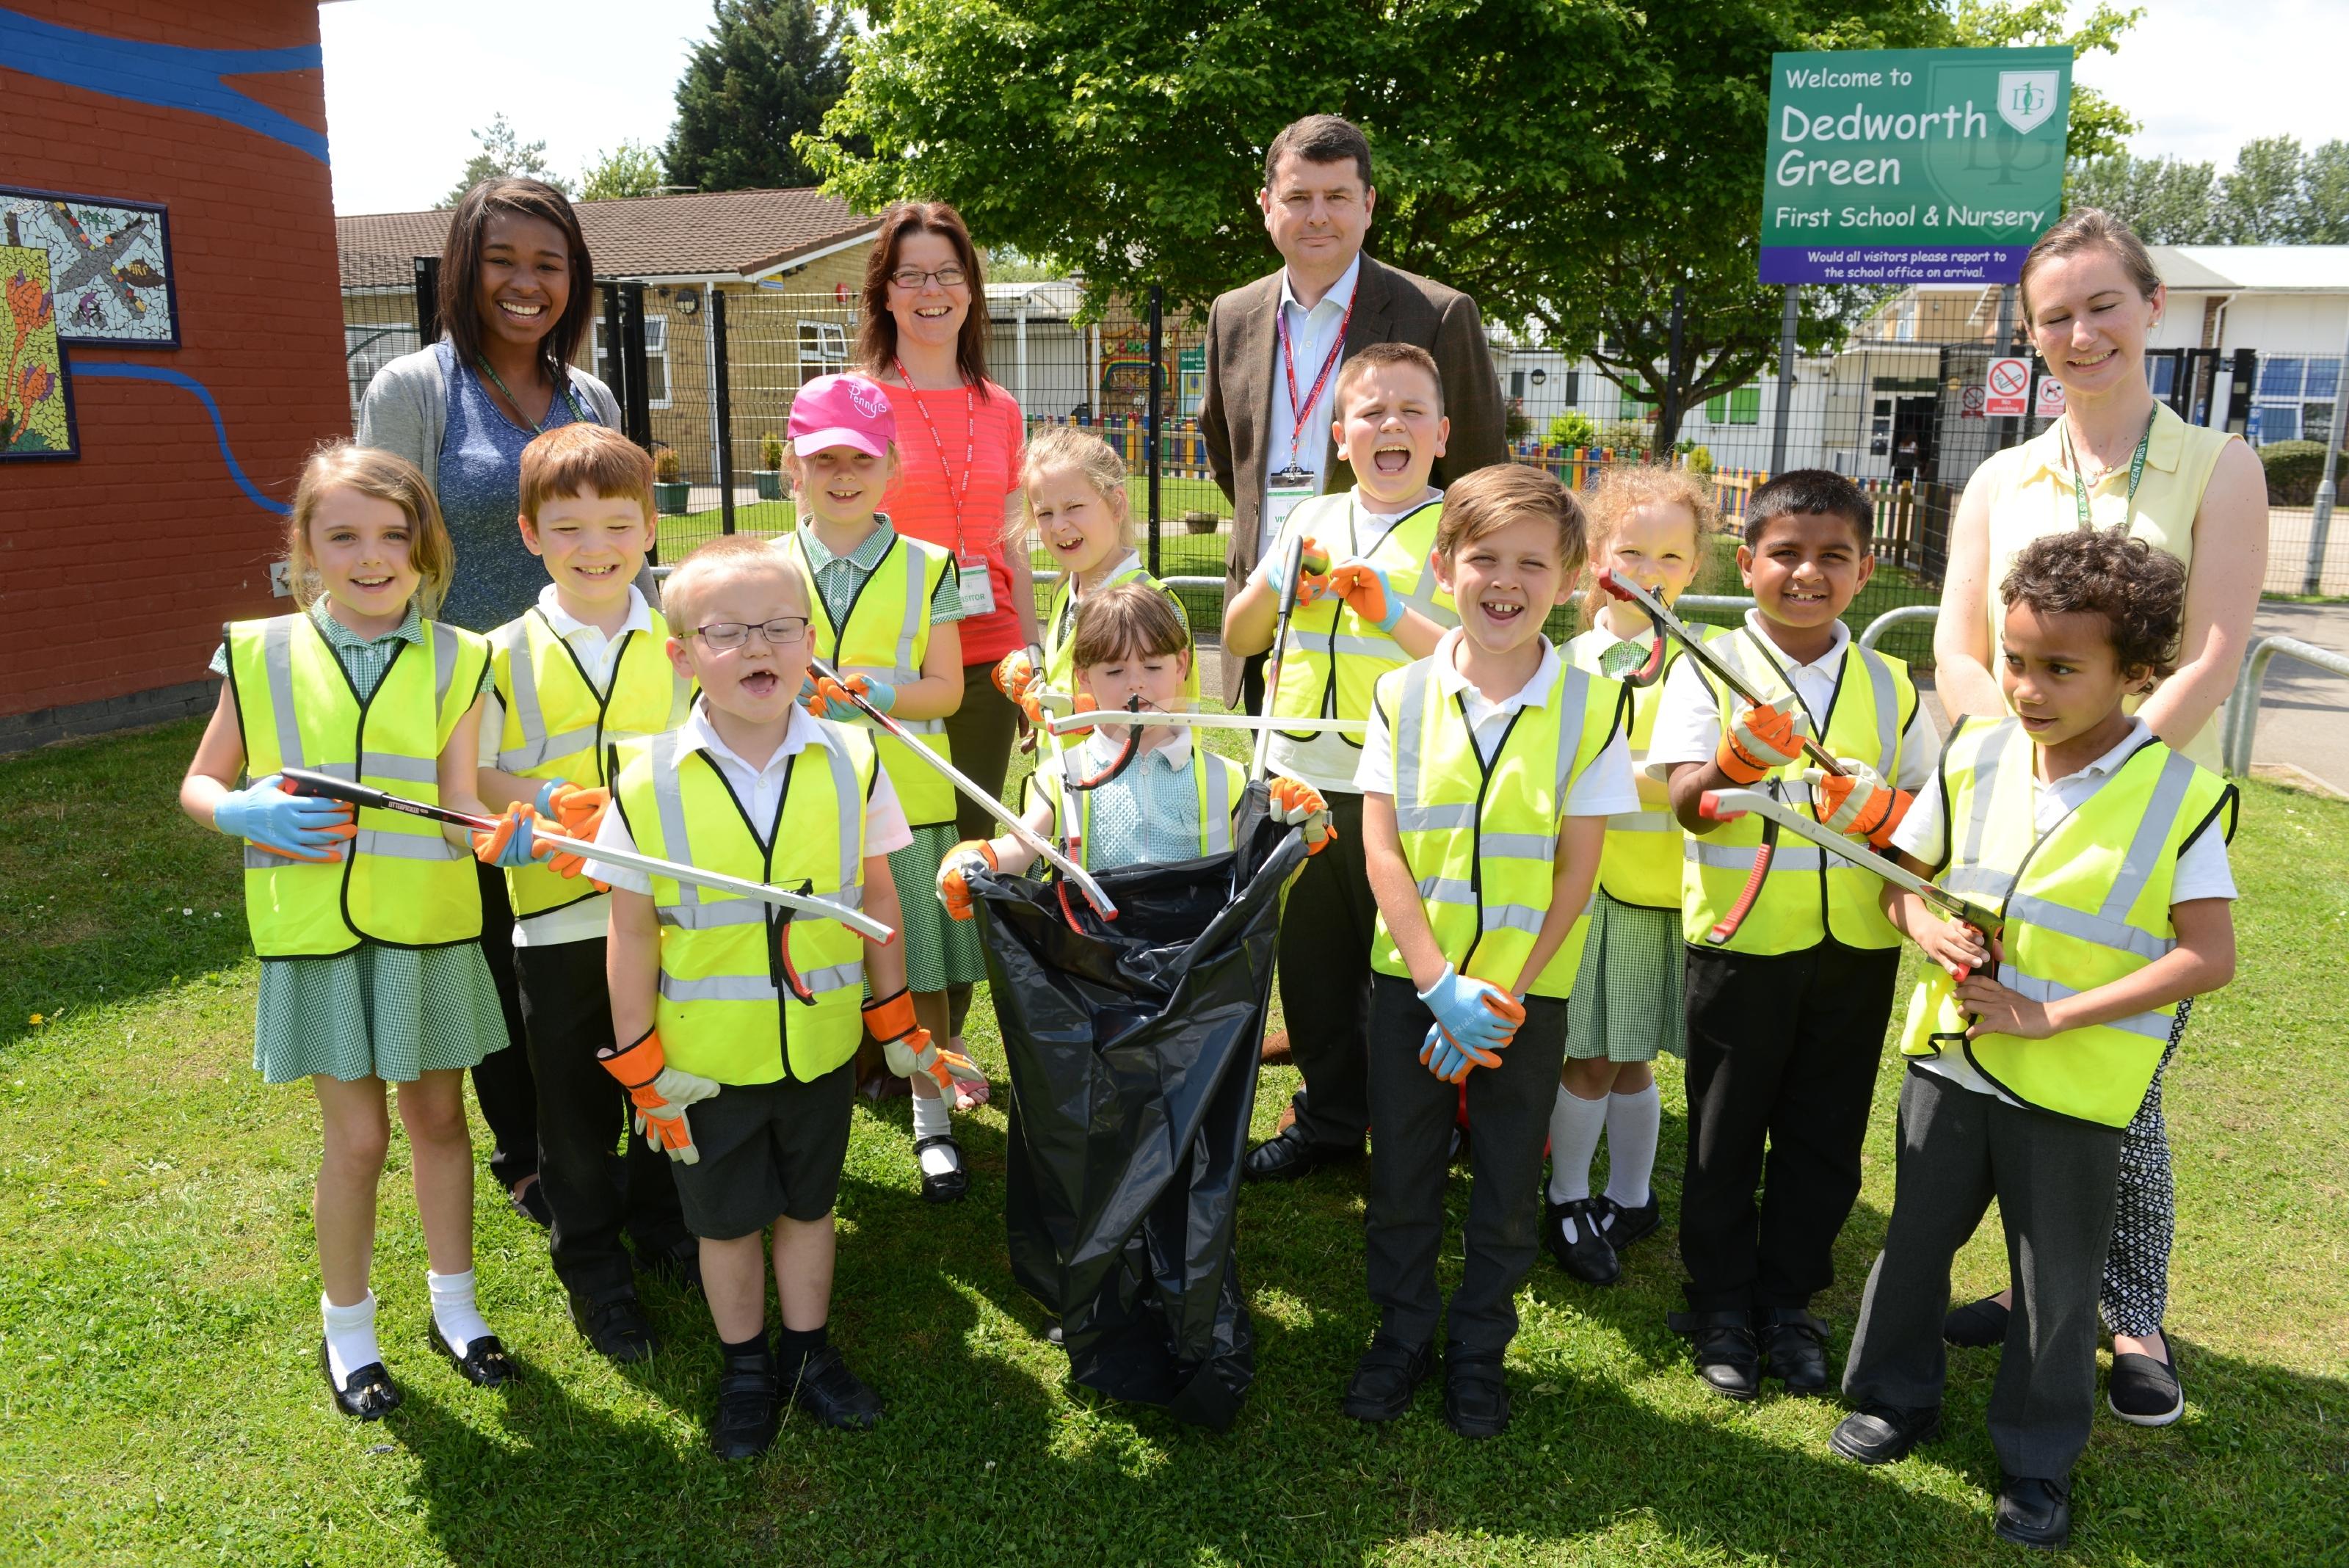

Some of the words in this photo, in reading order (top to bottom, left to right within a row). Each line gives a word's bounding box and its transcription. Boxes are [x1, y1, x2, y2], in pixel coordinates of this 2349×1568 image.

[1786, 68, 1882, 89] Welcome
[1889, 68, 1912, 87] to
[1780, 100, 1987, 142] Dedworth
[1776, 149, 1900, 186] Green
[1775, 207, 1832, 228] First
[1839, 206, 1916, 227] School
[1923, 206, 1939, 227] &
[1947, 206, 2044, 233] Nursery
[1807, 251, 1844, 263] Would
[1846, 250, 1860, 263] all
[1863, 250, 1908, 263] visitors
[1911, 251, 1948, 265] please
[1950, 252, 1991, 264] report
[1993, 251, 2007, 263] to
[1825, 266, 1844, 278] the
[1847, 266, 1884, 278] school
[1887, 266, 1925, 278] office
[1927, 269, 1942, 278] on
[1943, 266, 1986, 278] arrival.
[904, 375, 917, 393] VISITOR
[568, 399, 584, 422] GREEN
[847, 382, 878, 418] Penny
[918, 399, 930, 419] VISITOR
[931, 427, 941, 447] VISITOR
[2135, 443, 2146, 465] FIRST
[962, 471, 970, 491] VISITOR
[2130, 468, 2141, 497] GREEN
[962, 593, 985, 602] ISITOR
